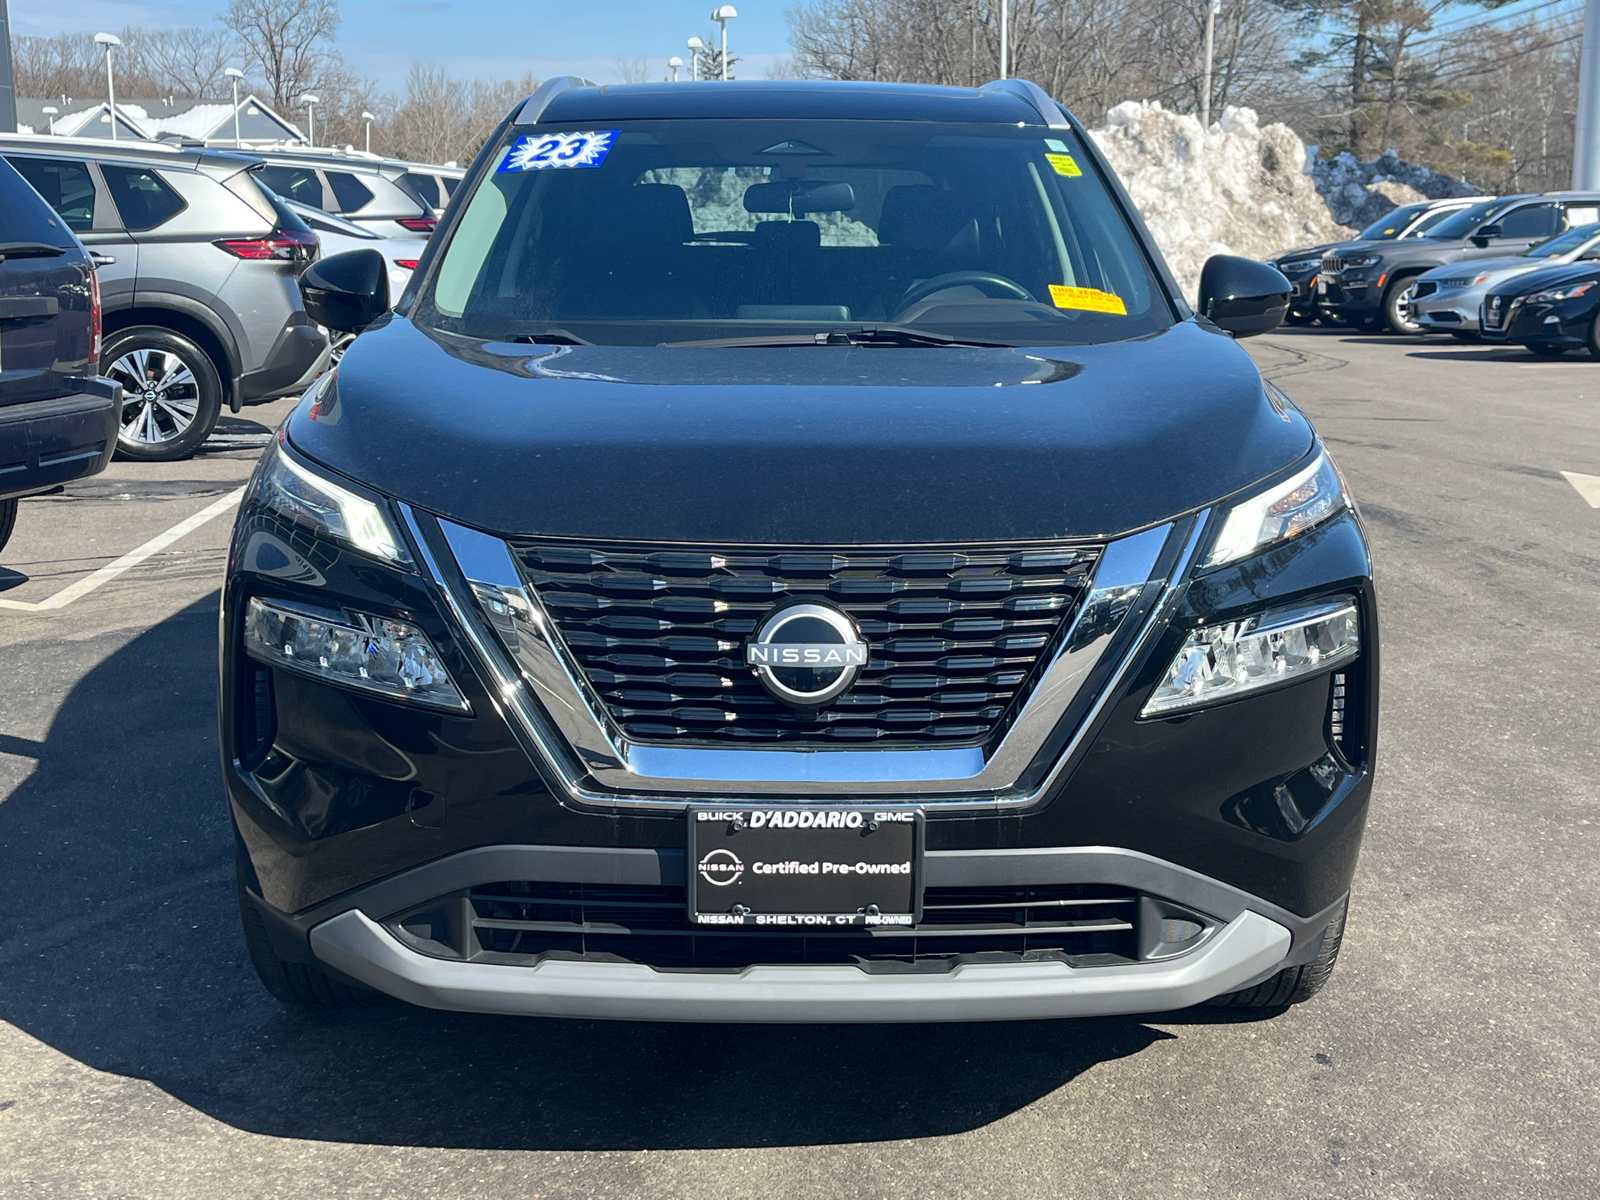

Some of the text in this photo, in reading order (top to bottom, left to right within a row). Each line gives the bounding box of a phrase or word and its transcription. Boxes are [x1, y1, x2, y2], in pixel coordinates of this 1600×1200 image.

[526, 138, 589, 162] 23
[1052, 286, 1075, 294] THIS
[750, 647, 863, 663] NISSAN
[697, 810, 914, 828] BUICK D'ADDARIO GMC
[698, 863, 745, 872] NISSAN
[752, 861, 911, 874] Certified Pre-Owned
[697, 915, 912, 925] NISSAN SHELTON, CT PRE-OWNED
